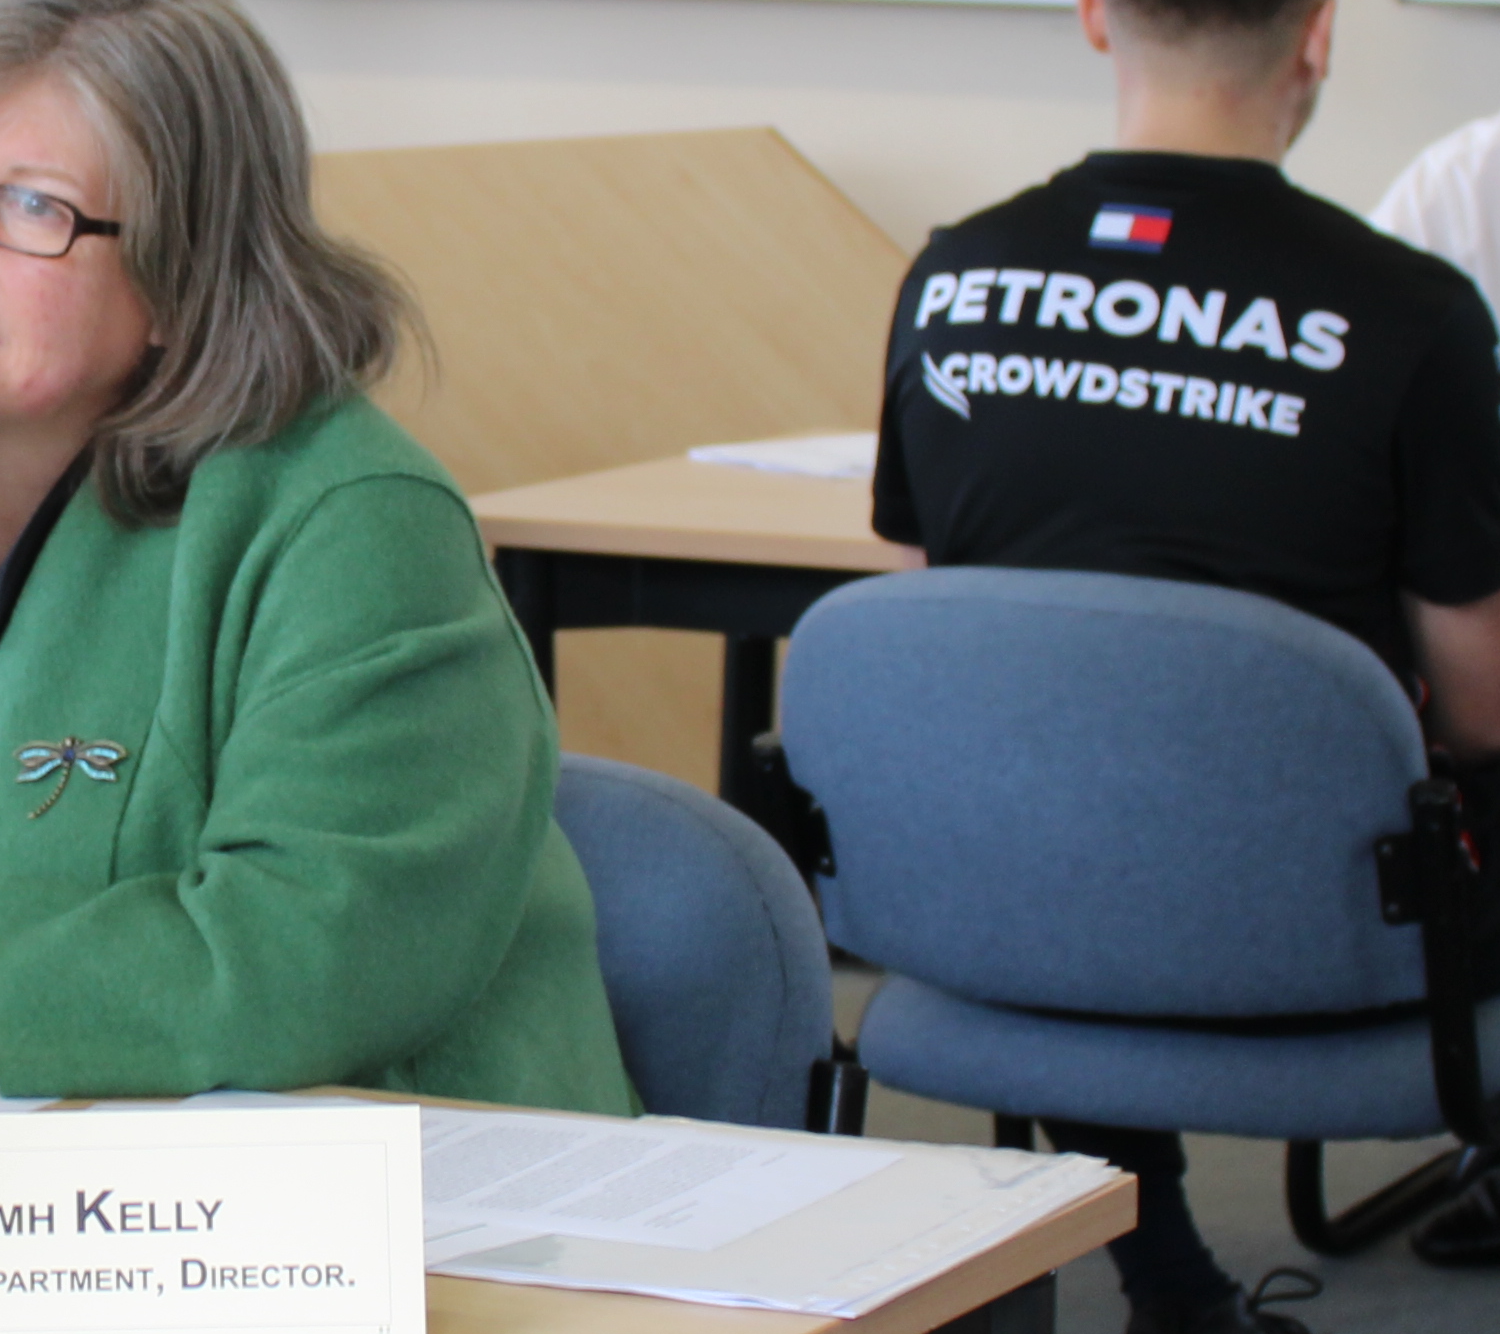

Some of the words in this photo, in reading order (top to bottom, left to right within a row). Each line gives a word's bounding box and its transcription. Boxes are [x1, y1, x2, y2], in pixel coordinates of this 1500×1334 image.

[915, 268, 1351, 371] PETRONAS
[938, 352, 1306, 436] CROWDSTRIKE
[75, 1189, 224, 1234] KELLY
[180, 1257, 357, 1292] DIRECTOR.
